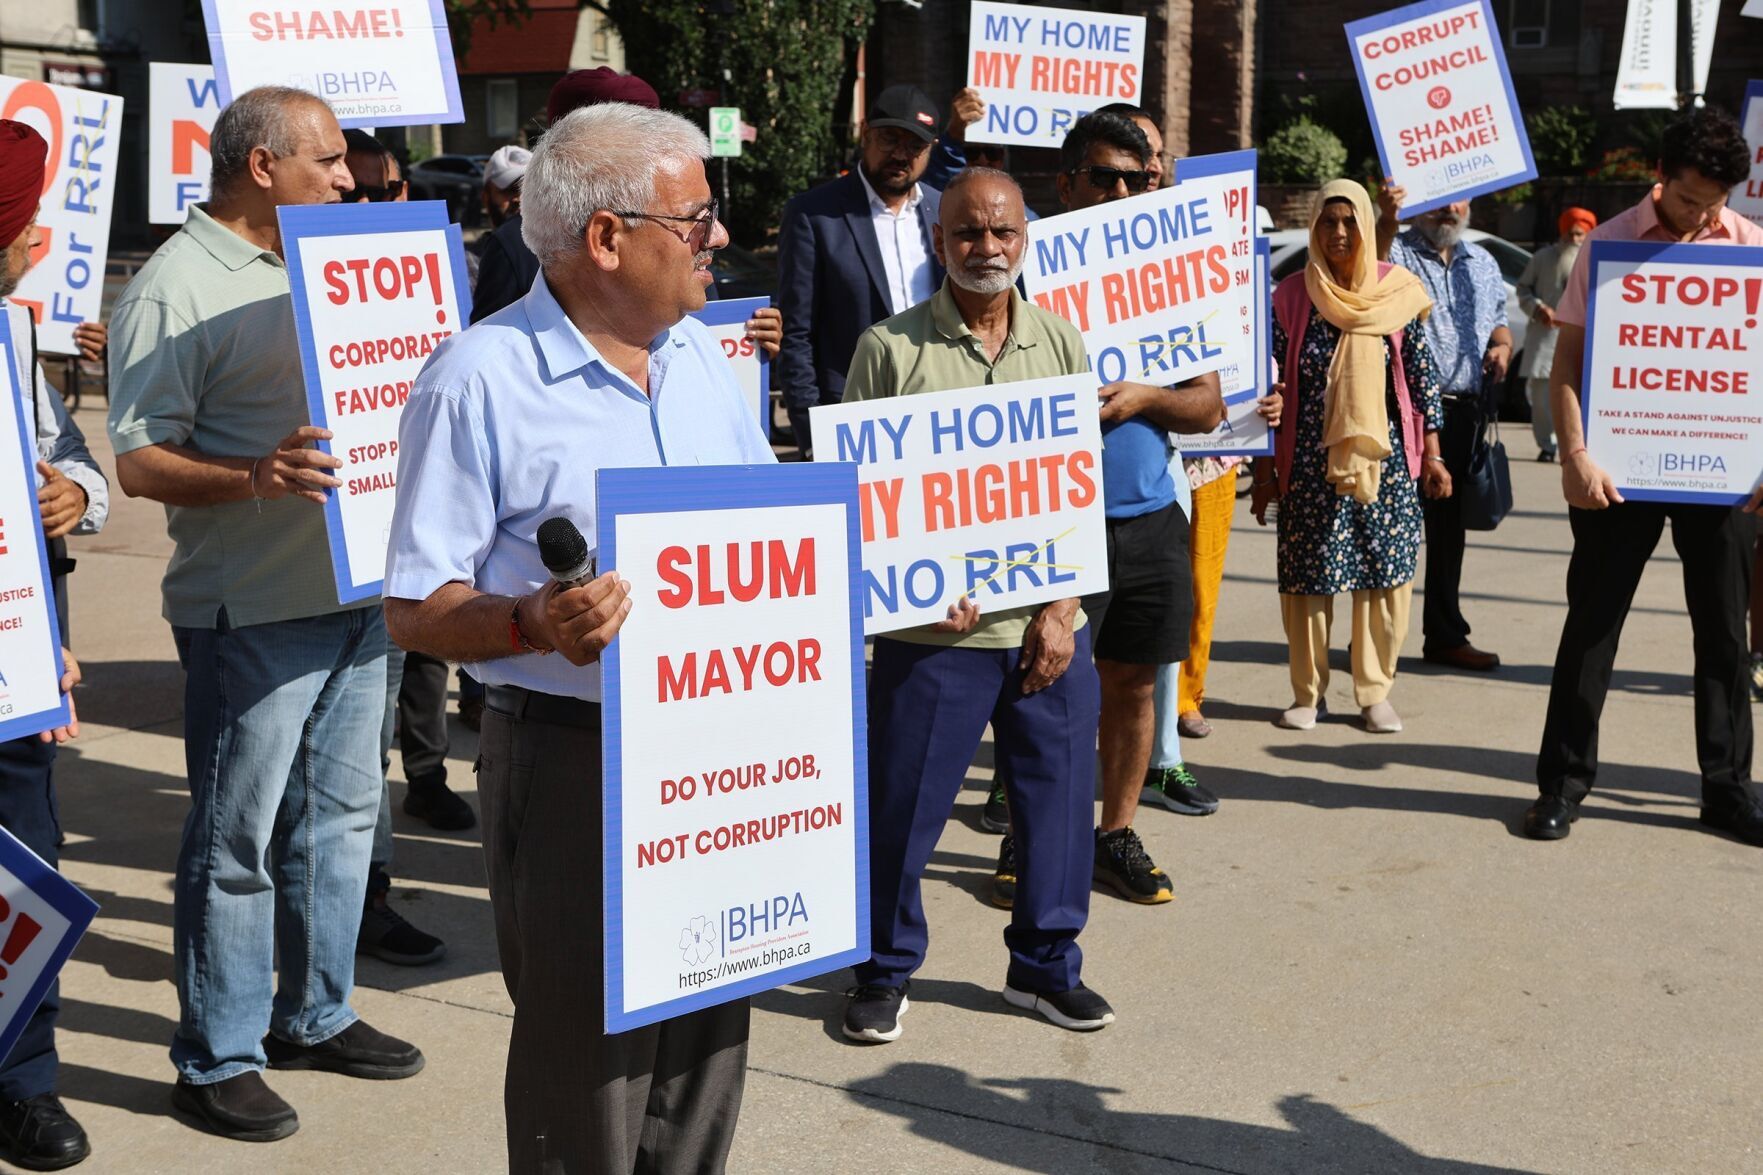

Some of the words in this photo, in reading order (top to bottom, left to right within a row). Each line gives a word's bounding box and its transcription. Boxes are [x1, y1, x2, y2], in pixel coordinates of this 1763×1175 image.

[249, 9, 404, 41] SHAME!
[985, 14, 1031, 43] MY
[1041, 19, 1131, 53] HOME
[1364, 11, 1480, 59] CORRUPT
[323, 70, 396, 95] BHPA
[974, 51, 1021, 89] MY
[1031, 56, 1137, 98] RIGHTS
[1375, 46, 1487, 91] COUNCIL
[333, 103, 402, 115] ww.bhpa.ca
[987, 104, 1038, 136] NO
[1399, 104, 1494, 147] SHAME!
[64, 99, 108, 215] RRL
[1404, 125, 1499, 167] SHAME!
[1448, 154, 1494, 177] BHPA
[1035, 228, 1089, 277] MY
[1103, 198, 1213, 259] HOME
[52, 232, 93, 323] For
[323, 252, 447, 325] STOP!
[1102, 245, 1230, 325] RIGHTS
[1621, 273, 1763, 329] STOP!
[1086, 346, 1127, 386] O
[1138, 321, 1222, 377] RRL
[1618, 324, 1747, 351] RENTAL
[1612, 367, 1749, 394] LICENSE
[836, 414, 913, 466] MY
[930, 392, 1078, 455] HOME
[1598, 409, 1621, 418] TAKE
[1632, 411, 1665, 419] STAND
[1666, 413, 1709, 421] AGAINST
[1710, 415, 1763, 424] UNJUSTICE
[1612, 427, 1626, 435] WE
[1628, 428, 1649, 436] CAN
[1651, 429, 1678, 437] MAKE
[1680, 430, 1687, 438] A
[1689, 431, 1748, 440] DIFFERENCE!
[349, 443, 386, 464] STOP
[1664, 453, 1726, 473] BHPA
[348, 472, 396, 496] SMALL
[922, 450, 1096, 532] RIGHTS
[1627, 476, 1728, 489] https://www.bhpa.ca
[657, 537, 816, 609] SLUM
[862, 558, 945, 618] NO
[965, 539, 1076, 599] RRL
[657, 638, 822, 703] MAYOR
[661, 776, 697, 805] DO
[702, 763, 766, 796] YOUR
[772, 754, 821, 784] JOB,
[638, 834, 689, 868] NOT
[695, 803, 842, 855] CORRUPTION
[729, 892, 808, 942] BHPA
[679, 942, 811, 989] https://www.bhpa.ca
